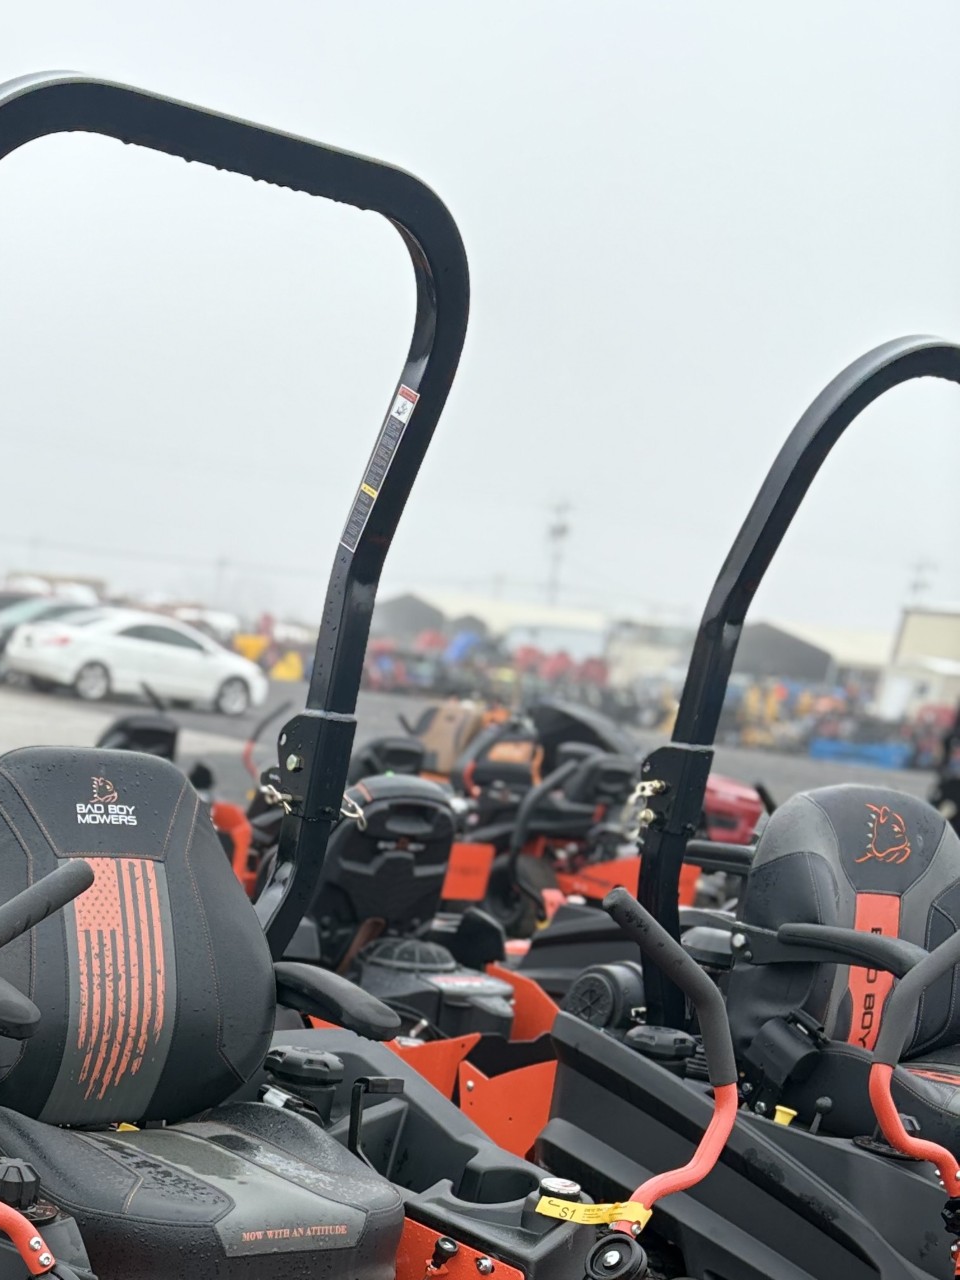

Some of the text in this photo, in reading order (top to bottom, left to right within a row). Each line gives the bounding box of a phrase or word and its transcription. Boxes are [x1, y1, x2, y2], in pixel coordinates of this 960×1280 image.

[76, 803, 135, 815] BAD BOY
[77, 814, 138, 826] MOWERS
[858, 993, 875, 1049] BOY
[242, 1225, 348, 1241] MOW WITH AN ATTITUDE
